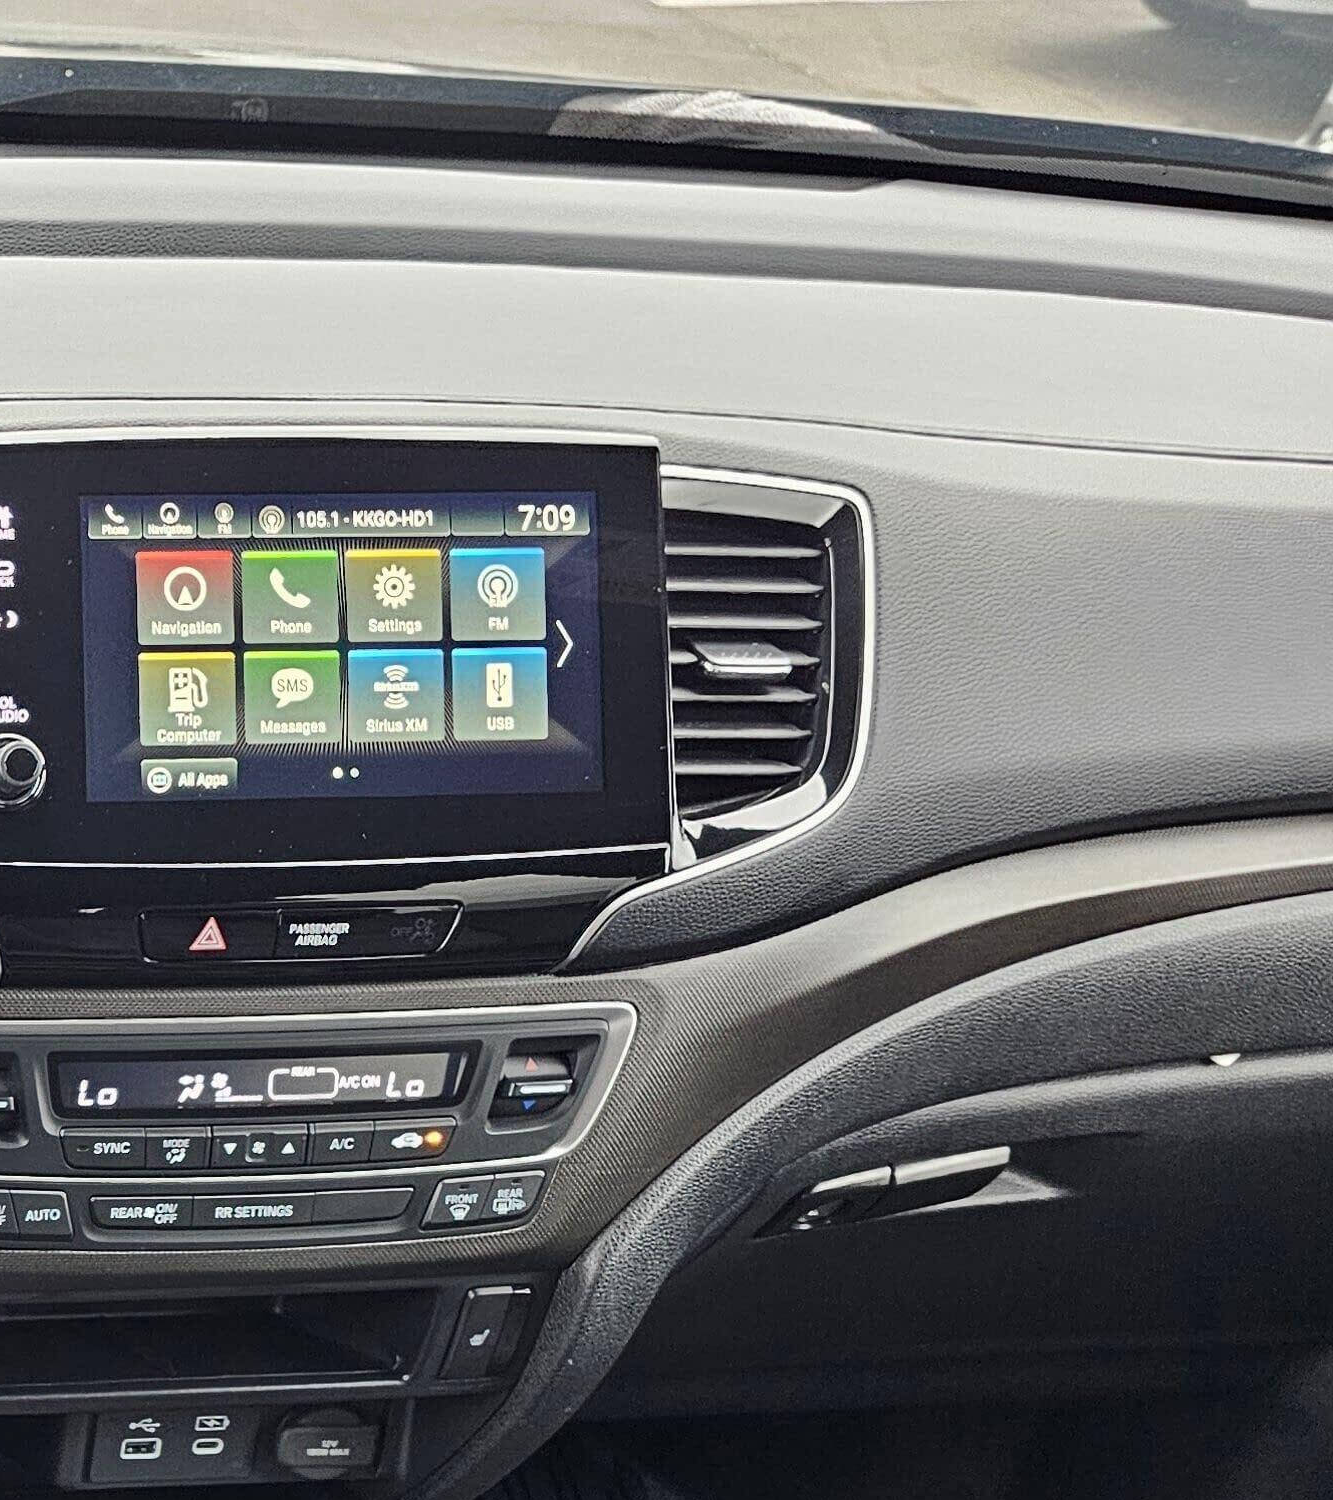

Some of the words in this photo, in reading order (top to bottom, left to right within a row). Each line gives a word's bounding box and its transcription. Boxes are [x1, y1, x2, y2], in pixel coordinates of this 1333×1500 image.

[297, 509, 340, 529] 105.1
[353, 508, 434, 529] KKGO-HD1
[517, 504, 576, 532] 7:09
[101, 525, 130, 536] Phone
[147, 523, 194, 537] Navigation
[151, 619, 223, 637] Navigation
[269, 619, 313, 635] Phone
[368, 618, 423, 636] Settings
[488, 616, 510, 632] FM
[277, 679, 309, 693] SMS
[175, 712, 203, 730] Trip
[260, 720, 327, 736] Messages
[365, 718, 404, 733] Sirius
[405, 717, 429, 732] XM
[486, 716, 515, 731] USB
[156, 728, 222, 745] Computer
[177, 773, 196, 788] All
[197, 773, 230, 790] Apps
[289, 922, 350, 935] PASSENGER
[295, 934, 338, 946] AIRBAG
[385, 1071, 426, 1098] Lo
[77, 1079, 118, 1107] Lo
[93, 1142, 131, 1155] SYNC
[162, 1139, 191, 1149] MODE
[329, 1137, 356, 1150] A/C
[444, 1193, 480, 1206] FRONT
[497, 1188, 523, 1199] REAR
[24, 1208, 62, 1222] AUTO
[110, 1206, 144, 1220] REAR
[155, 1203, 179, 1214] ON/
[214, 1206, 233, 1219] RR
[233, 1204, 294, 1219] SETTINGS
[154, 1213, 179, 1225] OFF
